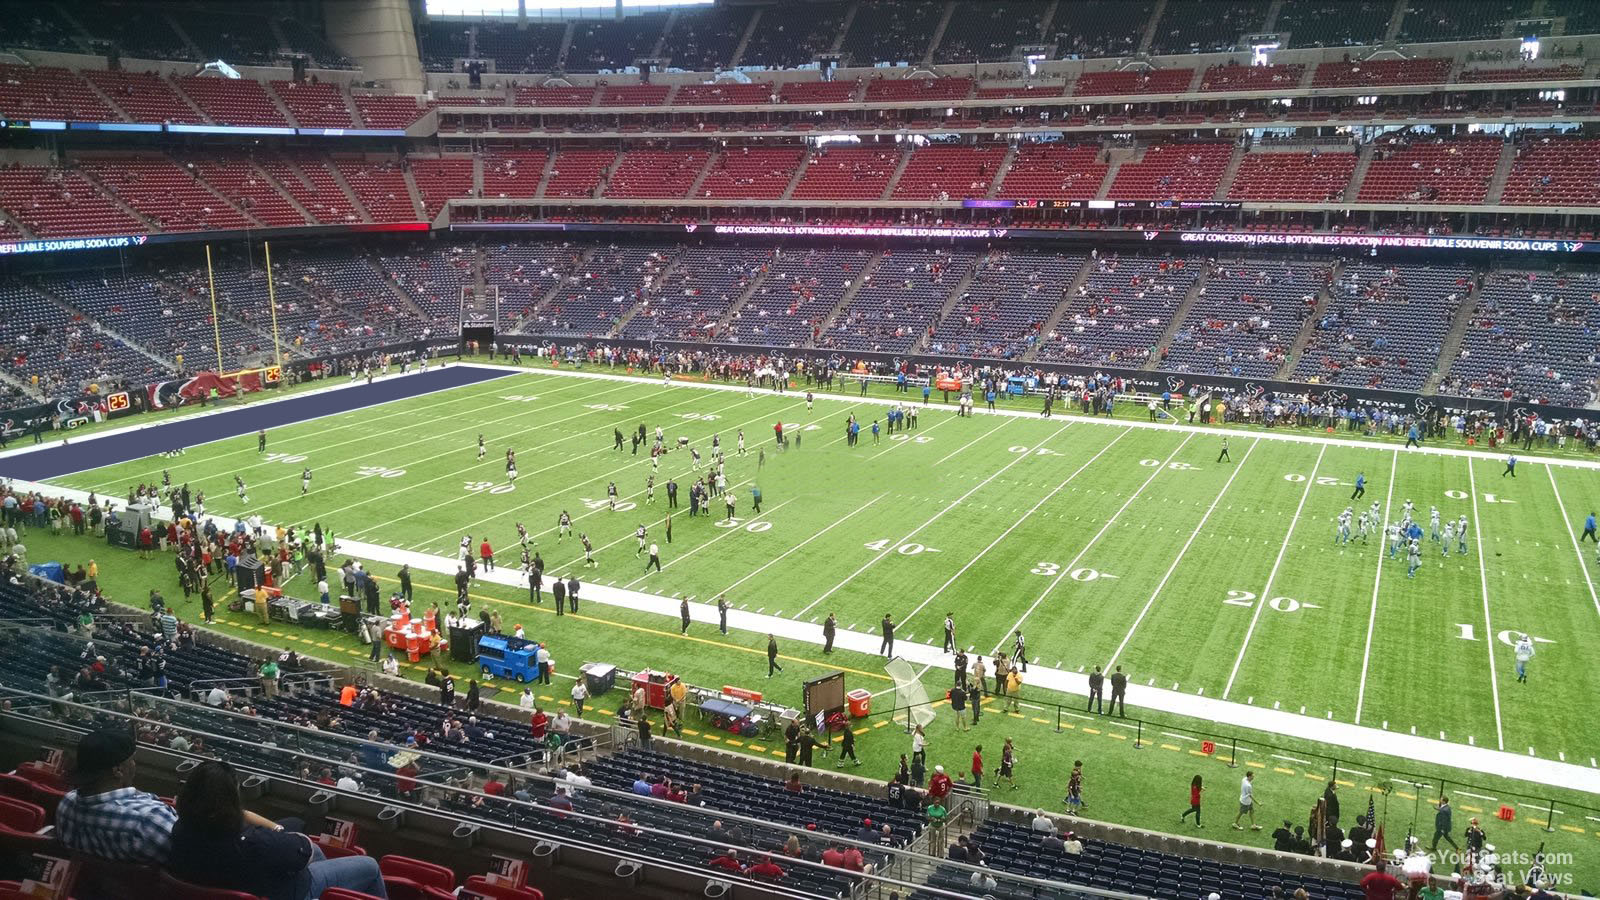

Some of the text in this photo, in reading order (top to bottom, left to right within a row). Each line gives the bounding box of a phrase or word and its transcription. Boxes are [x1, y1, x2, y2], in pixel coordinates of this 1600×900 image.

[715, 225, 734, 233] GREAT
[735, 226, 774, 234] CONCESSION
[774, 226, 794, 234] DEALS:
[795, 227, 836, 235] BOTTOMLESS
[836, 228, 866, 236] POPCORN
[866, 228, 881, 236] AND
[882, 228, 917, 236] REFILLABLE
[918, 229, 951, 237] SOUVENIR
[972, 230, 990, 238] CUPS
[45, 240, 85, 251] SOUVENIR
[86, 239, 108, 248] SODA
[109, 237, 129, 247] CUPS
[1181, 233, 1557, 251] GREAT CONCESSION DEALS: BOTTOMLESS POPCORN AND REFILLABLE SOUVENIR SODA CUPS
[110, 395, 127, 409] 25
[863, 538, 925, 555] 40
[1030, 562, 1099, 582] 30
[1223, 590, 1300, 612] 20
[389, 633, 397, 644] G
[860, 701, 868, 711] G
[1202, 741, 1214, 753] 20
[889, 789, 900, 799] 56
